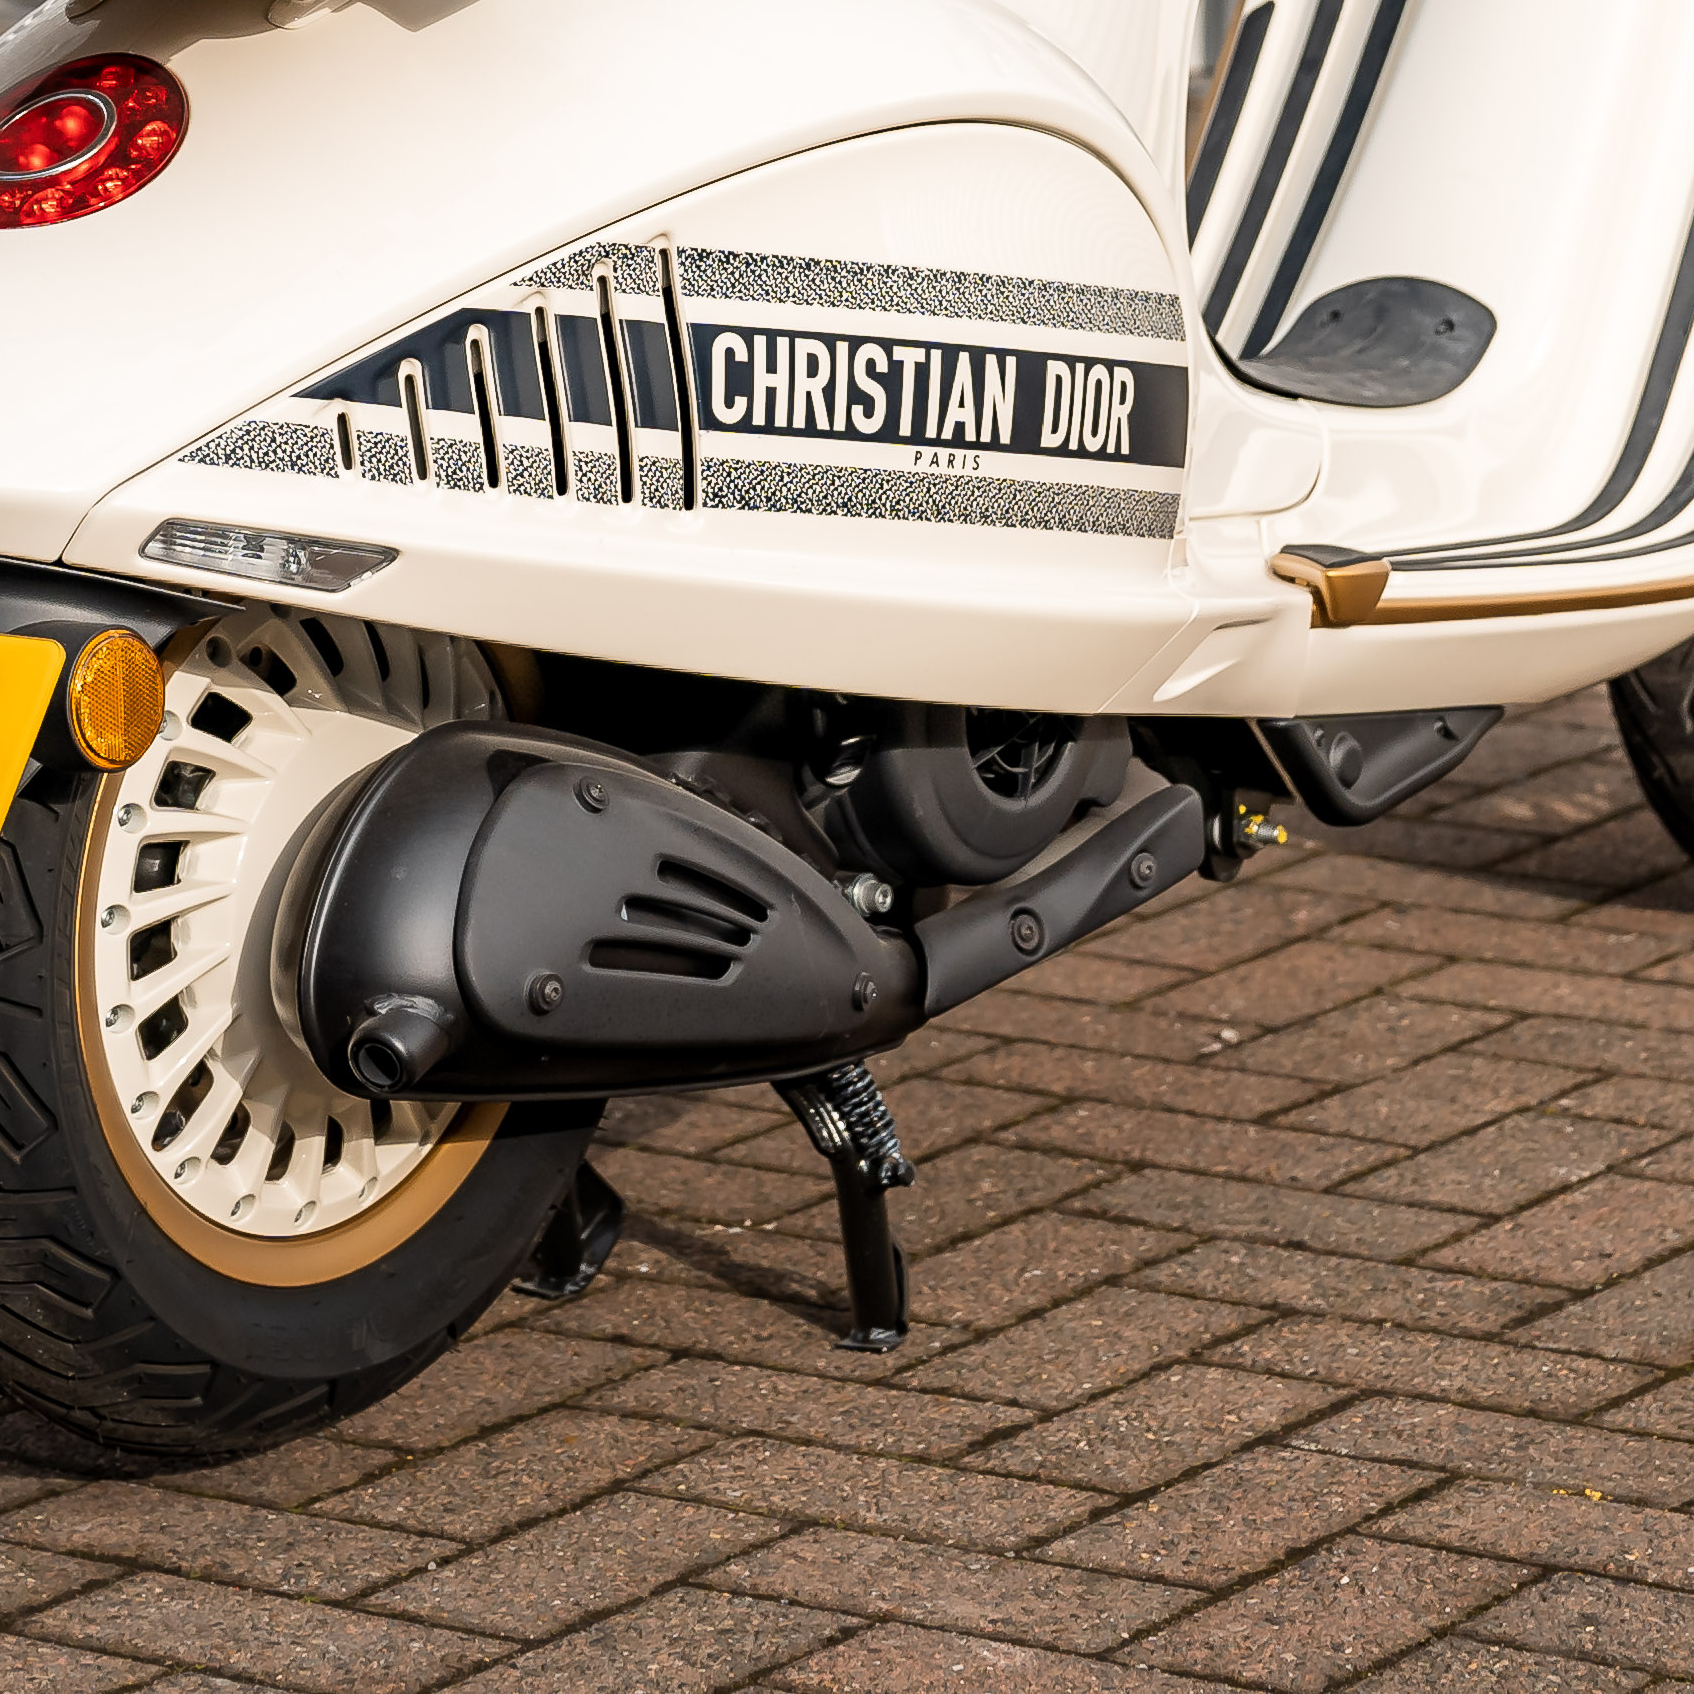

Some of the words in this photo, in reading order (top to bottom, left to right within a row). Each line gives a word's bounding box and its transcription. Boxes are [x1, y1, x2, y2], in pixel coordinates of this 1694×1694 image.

[710, 331, 1018, 445] CHRISTIAN
[1039, 359, 1136, 456] DIOR
[913, 449, 982, 472] PARIS
